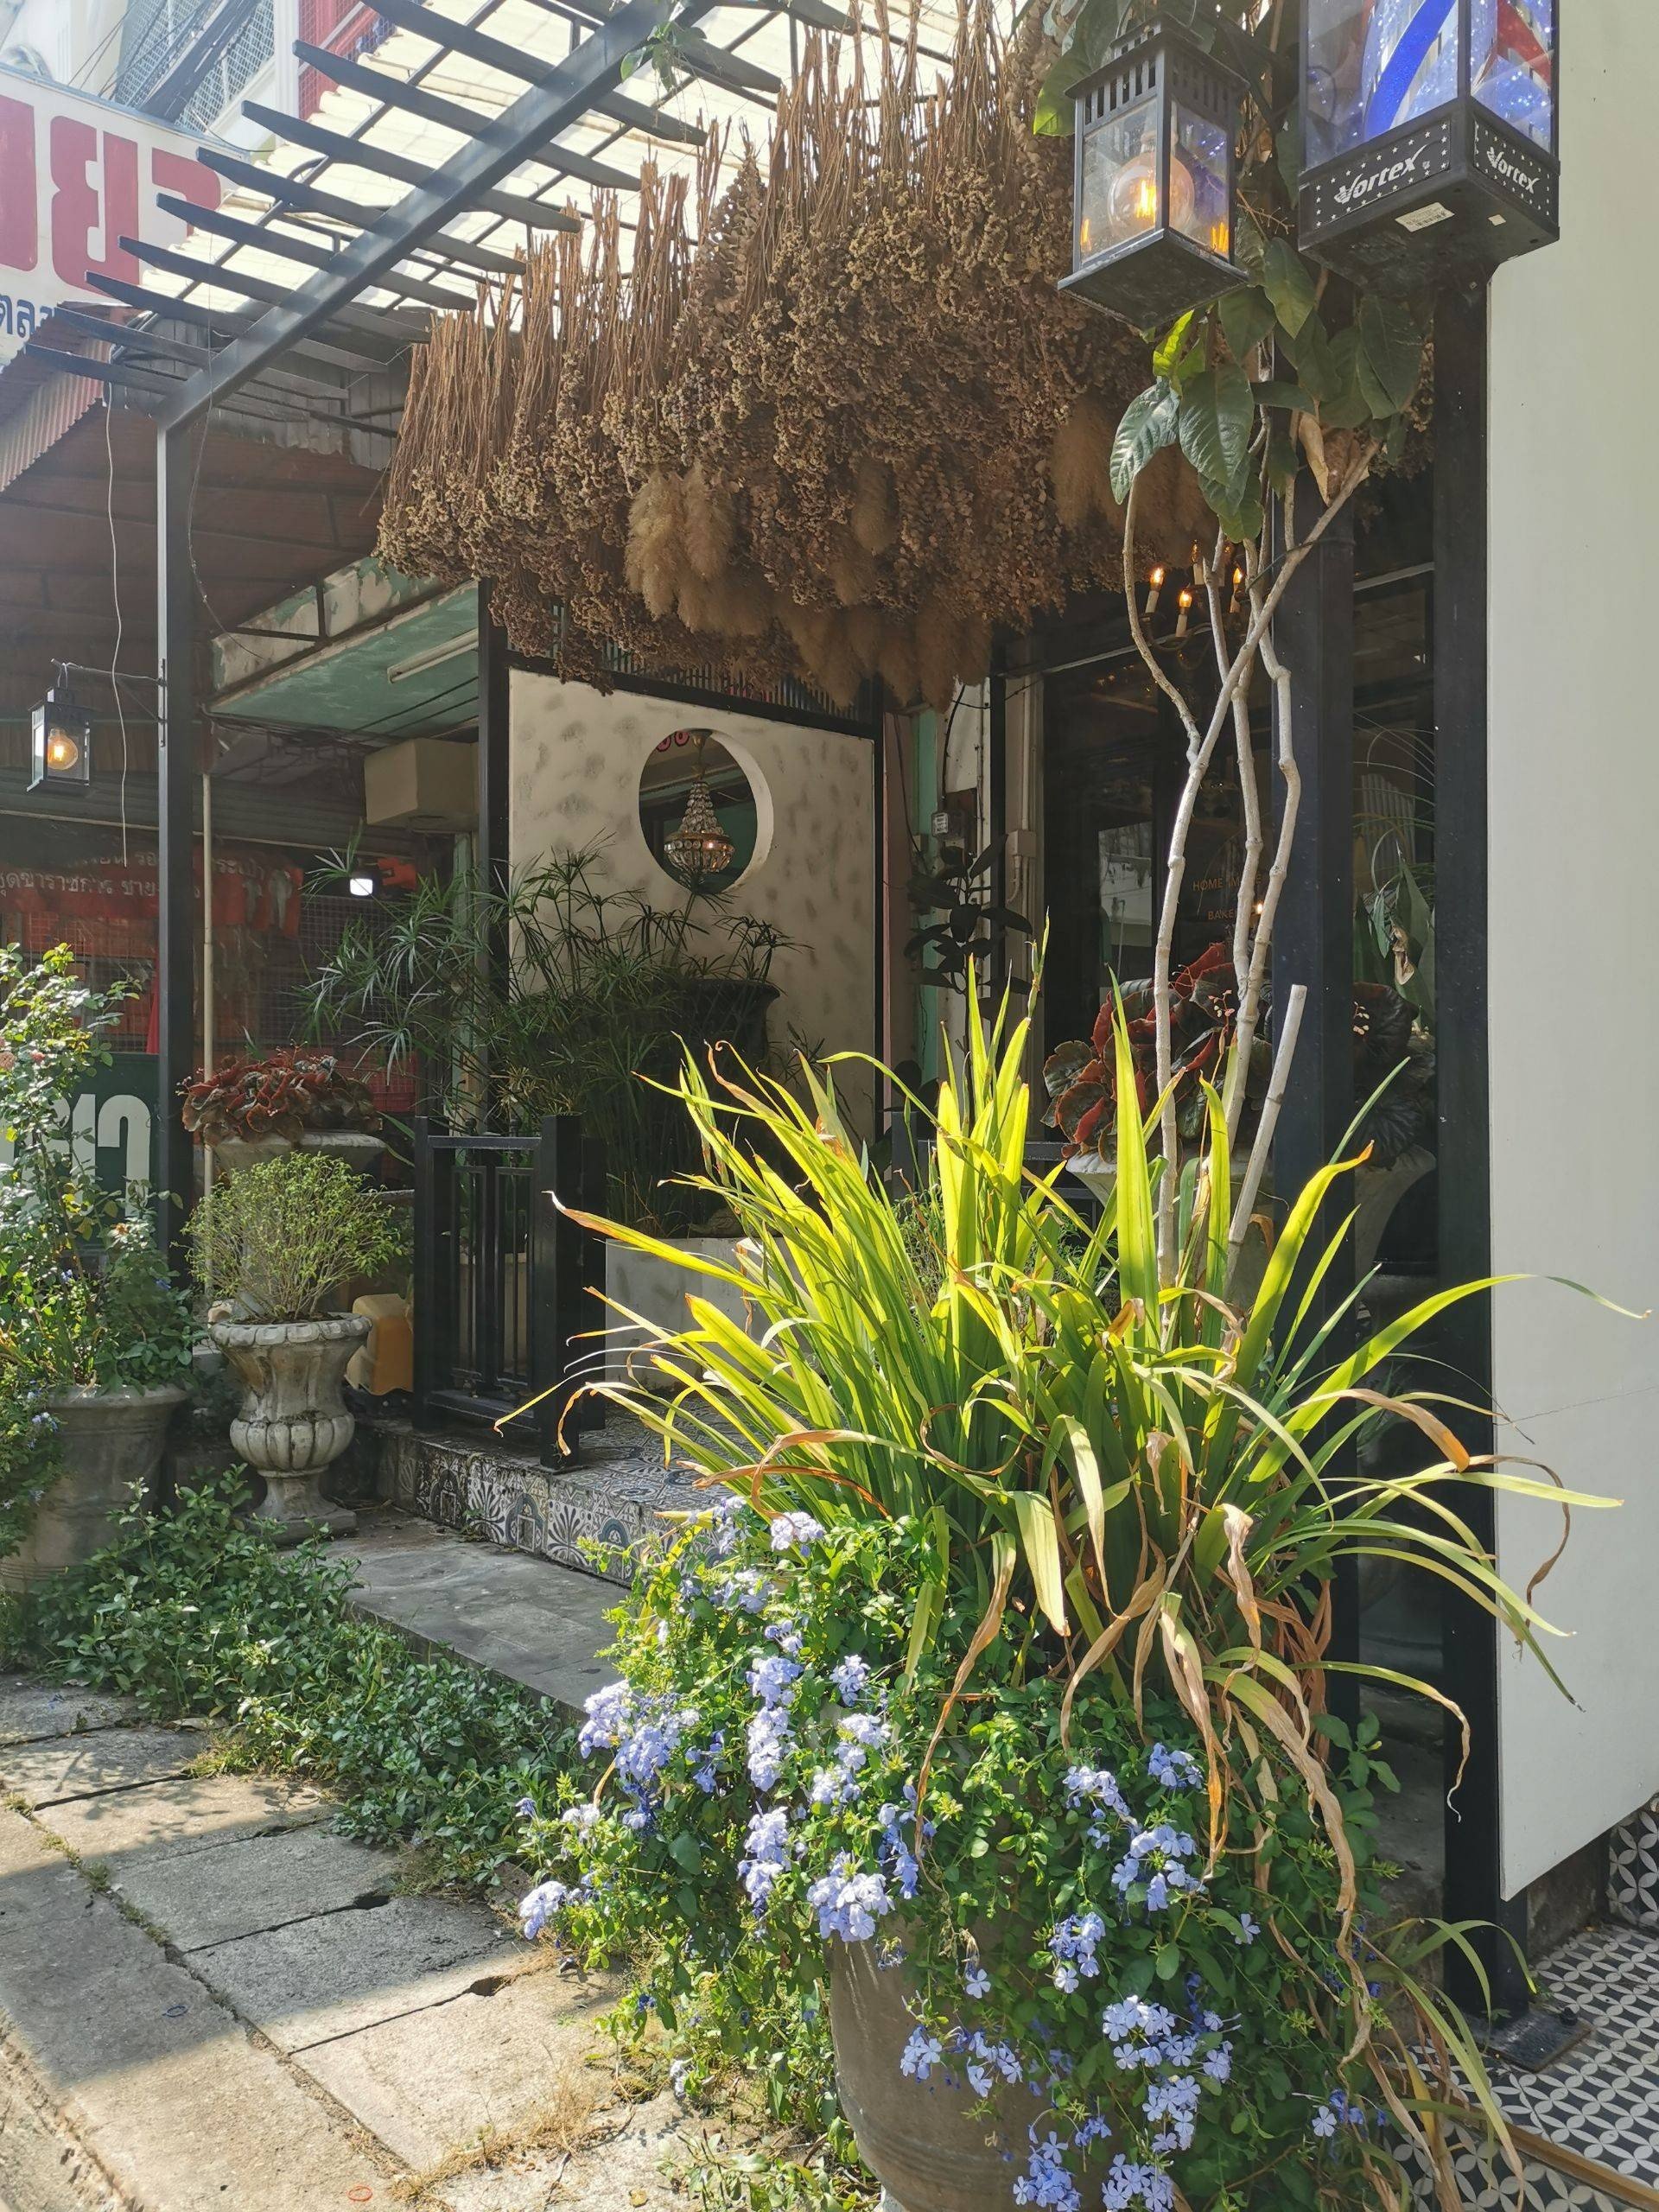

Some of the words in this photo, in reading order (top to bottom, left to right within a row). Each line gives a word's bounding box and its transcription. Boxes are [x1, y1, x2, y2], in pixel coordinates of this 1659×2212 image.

[1333, 144, 1427, 205] Vortex
[1486, 146, 1541, 194] Vortex
[1192, 877, 1224, 892] HOME
